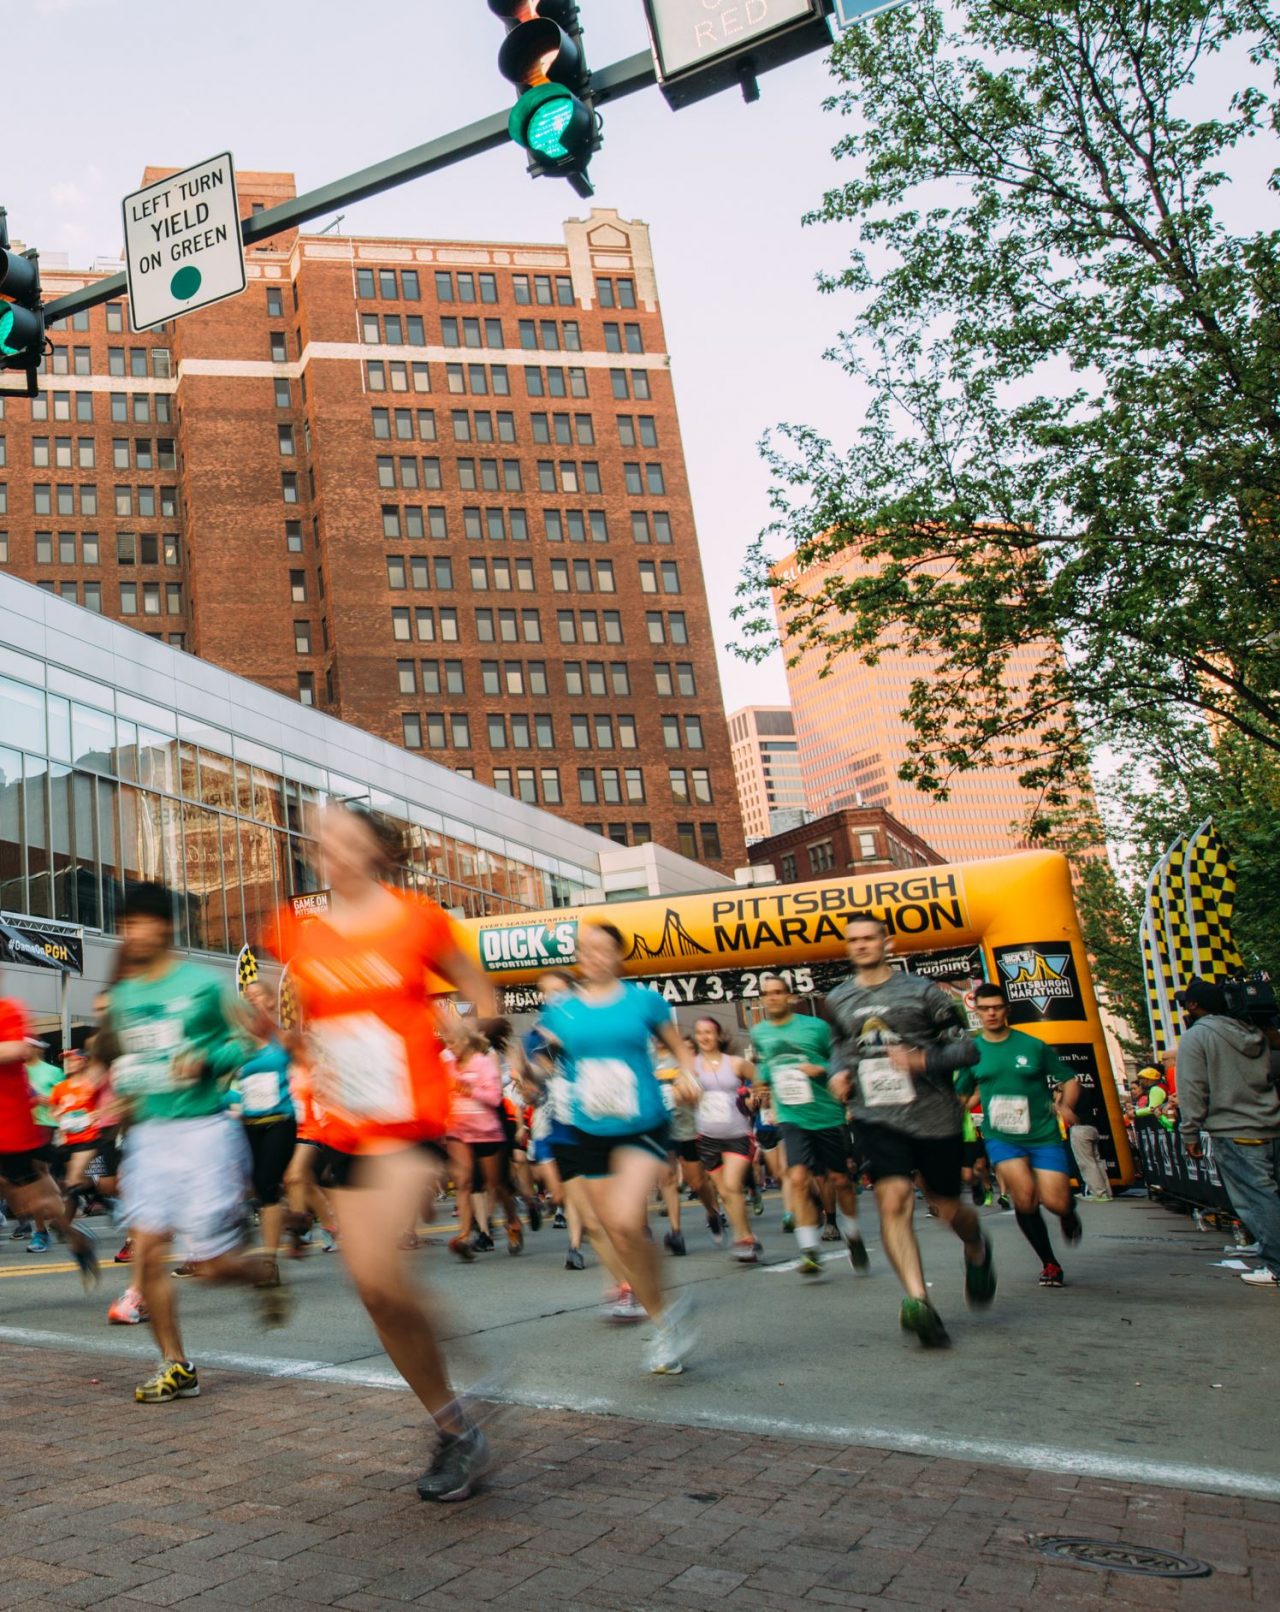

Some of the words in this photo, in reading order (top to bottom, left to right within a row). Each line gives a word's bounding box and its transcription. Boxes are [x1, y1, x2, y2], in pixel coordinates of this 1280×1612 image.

[693, 0, 768, 48] RED
[132, 191, 171, 222] LEFT
[179, 168, 223, 201] TURN
[151, 202, 209, 242] YIELD
[140, 251, 162, 274] ON
[171, 224, 227, 261] GREEN
[293, 897, 315, 910] GAME
[712, 873, 958, 923] PITTSBURGH
[483, 923, 576, 962] DICK'S
[488, 959, 539, 970] SPORTING
[541, 955, 577, 966] GOODS
[918, 961, 970, 976] running
[706, 976, 734, 1001] 3,
[1009, 980, 1068, 991] PITTSBURGH
[1010, 987, 1070, 999] MARATHON
